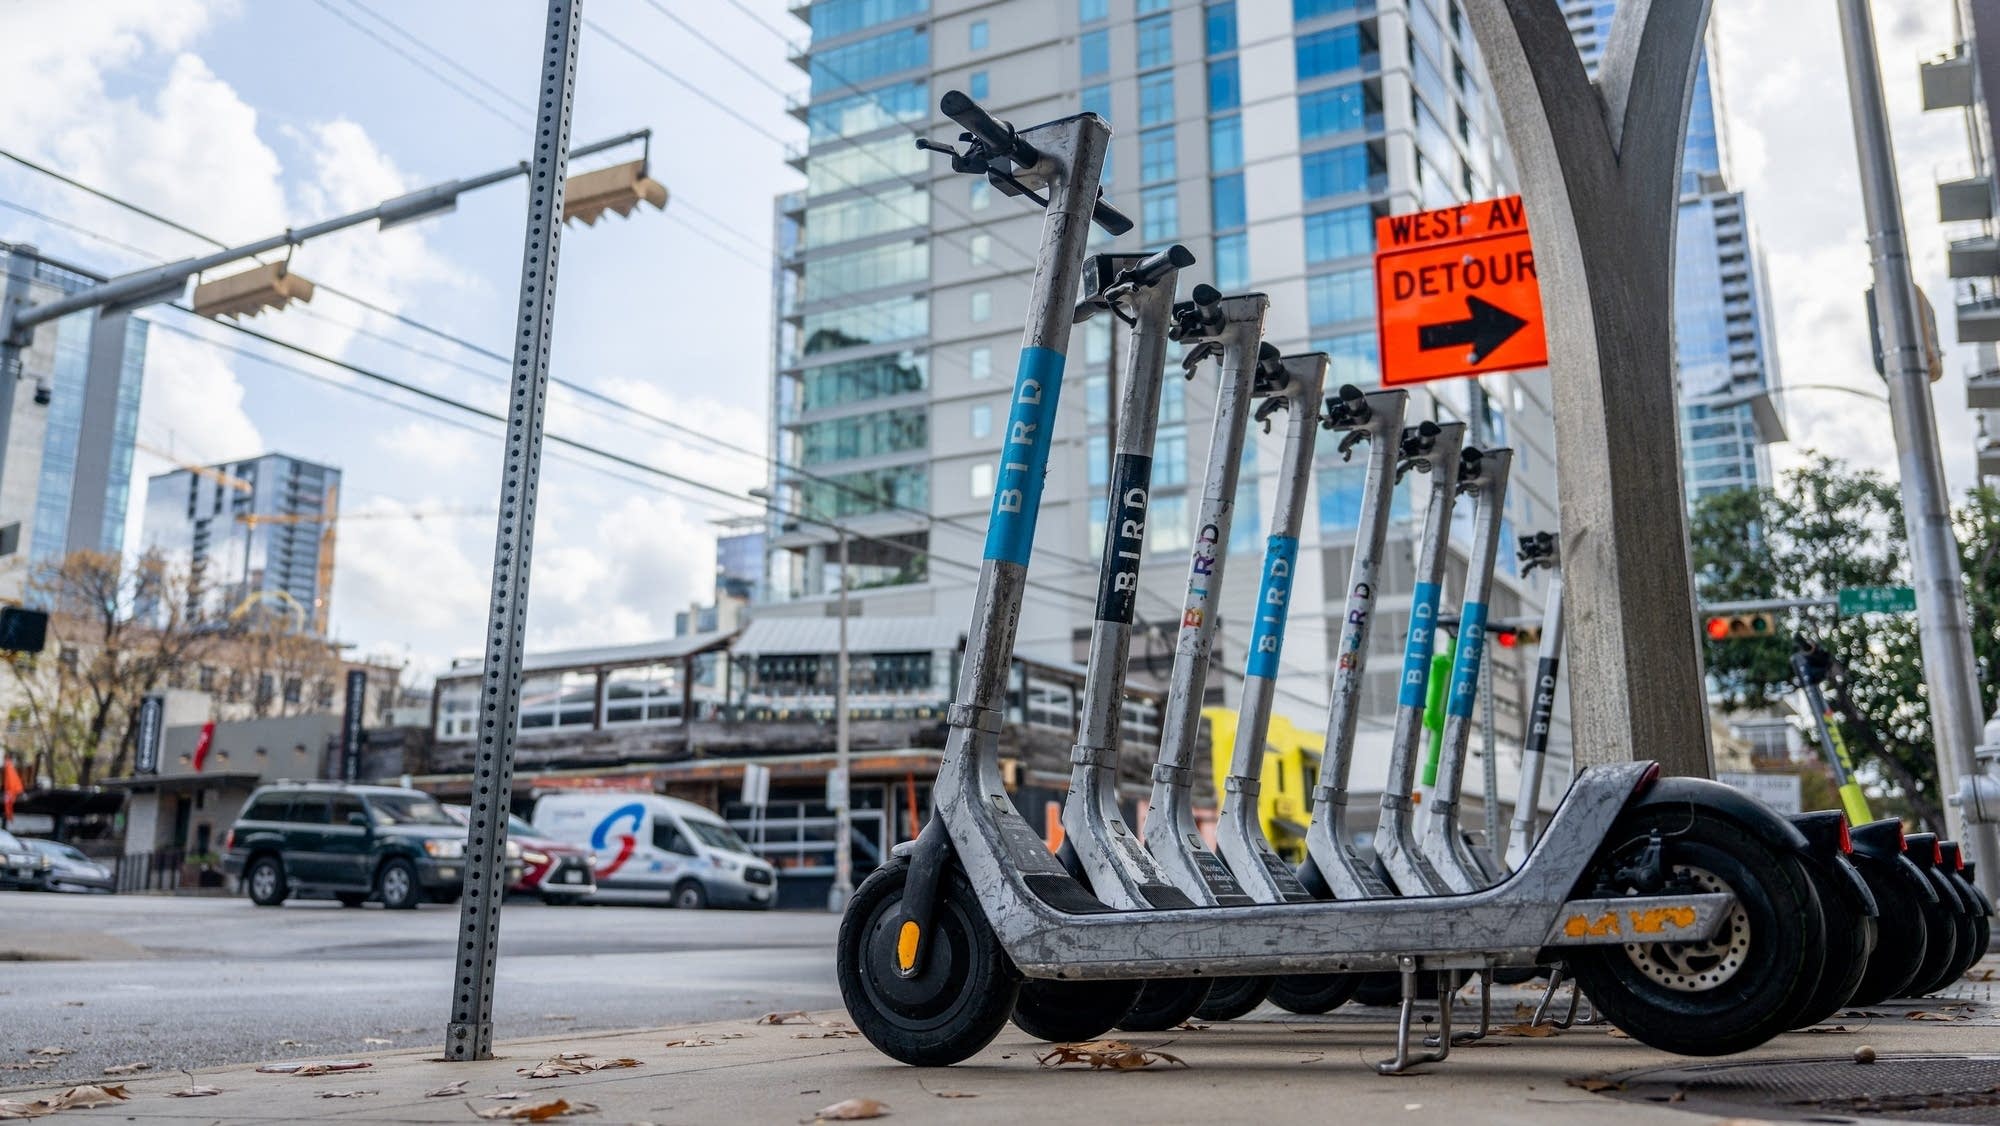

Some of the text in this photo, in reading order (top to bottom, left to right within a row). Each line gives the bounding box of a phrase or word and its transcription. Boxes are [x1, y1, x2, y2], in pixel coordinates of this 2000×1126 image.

[1389, 206, 1467, 245] WEST
[1394, 250, 1537, 301] DETOUR
[997, 378, 1042, 515] BIRD
[1114, 487, 1147, 593] BIRD
[1183, 524, 1219, 628] BIRD
[1258, 558, 1289, 653] BIRD
[1406, 602, 1432, 685] BIRD
[1457, 623, 1482, 695] BIRD
[1532, 675, 1555, 736] BIRD
